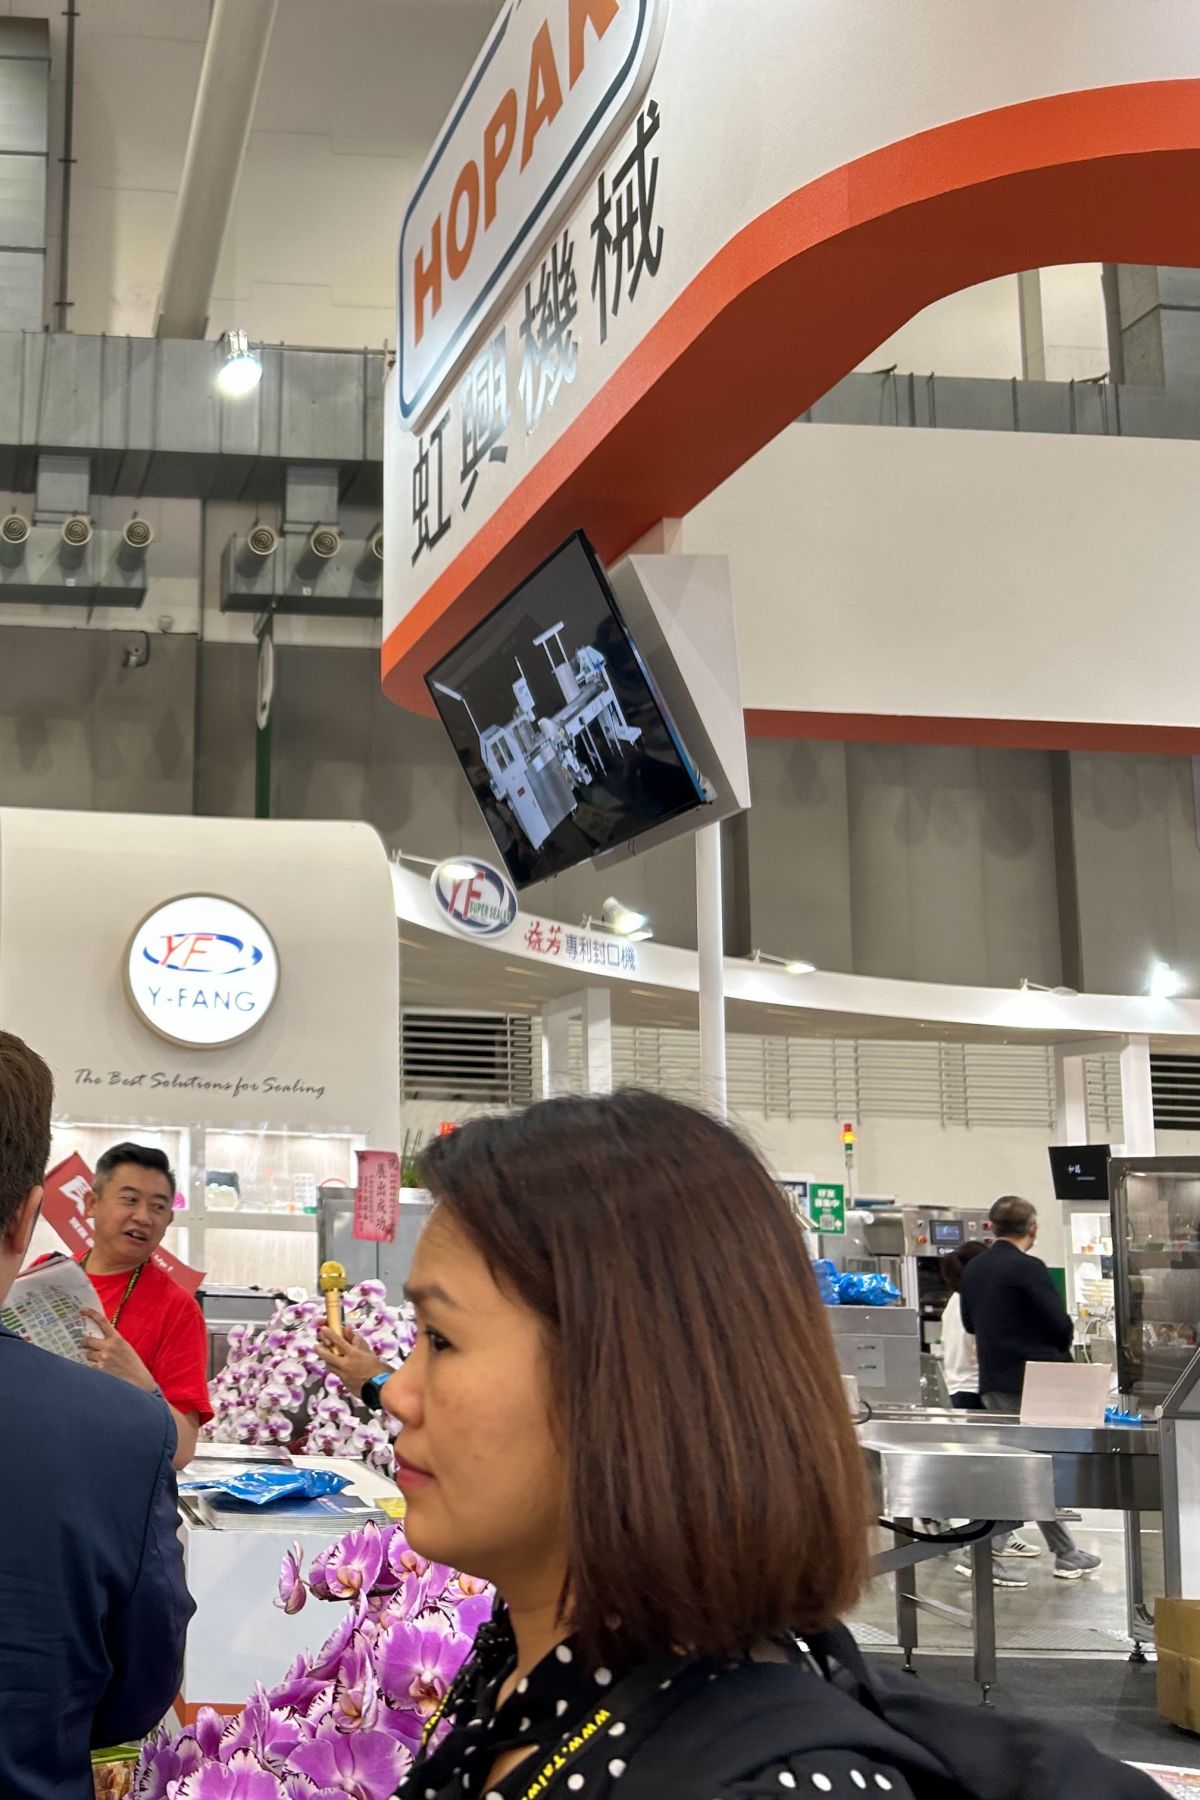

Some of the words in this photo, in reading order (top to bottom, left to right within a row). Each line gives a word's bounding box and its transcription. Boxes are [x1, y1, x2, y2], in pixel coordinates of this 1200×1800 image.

[149, 986, 256, 1012] Y-FANG
[74, 1068, 102, 1085] The
[107, 1071, 146, 1087] Best
[150, 1072, 231, 1091] Solutions
[232, 1077, 258, 1098] for
[262, 1077, 326, 1099] Sealing
